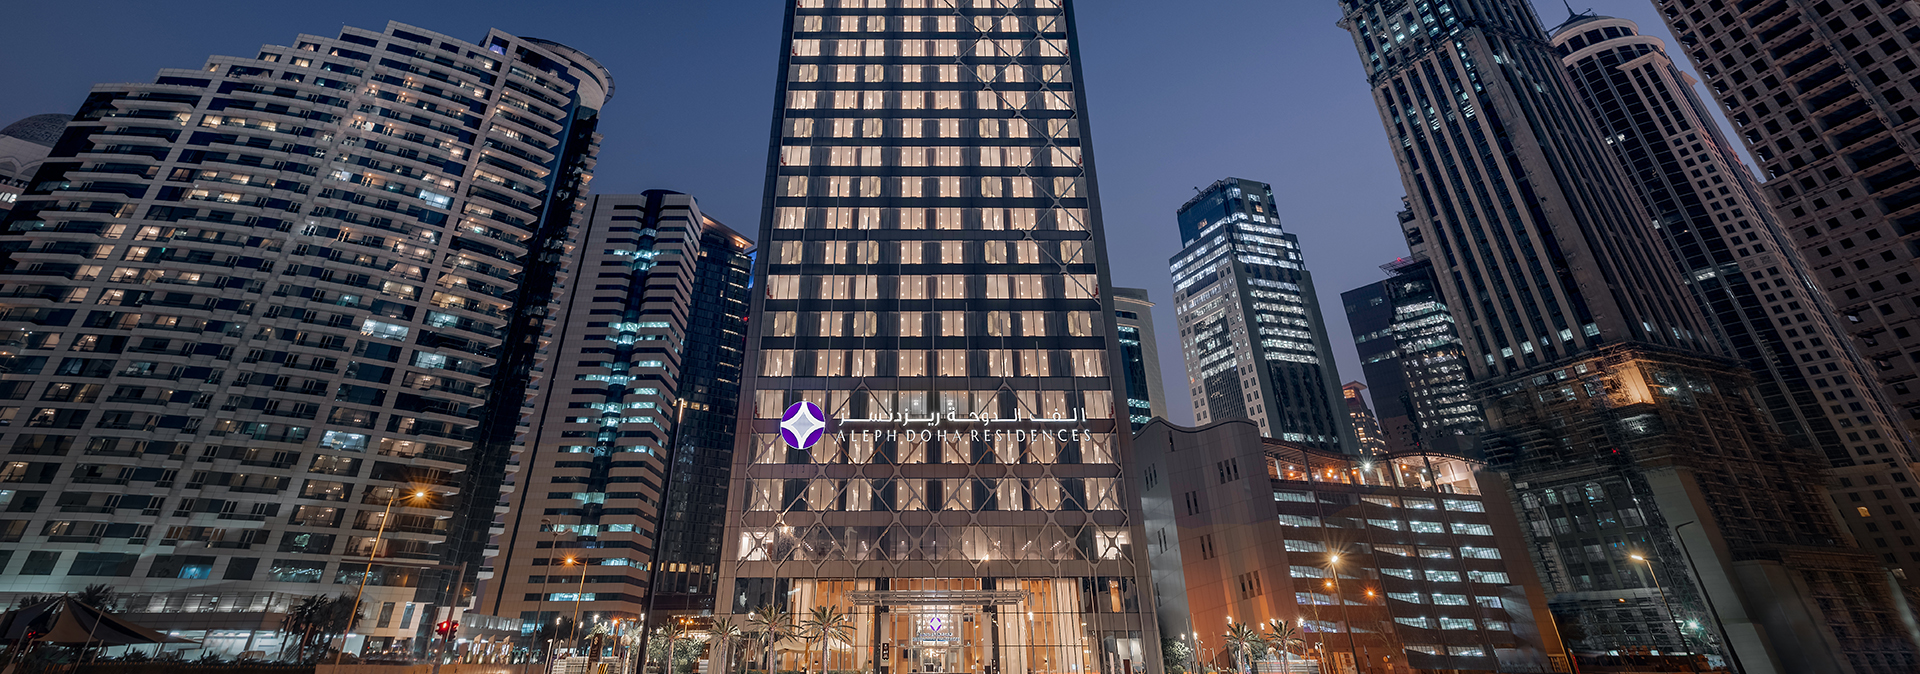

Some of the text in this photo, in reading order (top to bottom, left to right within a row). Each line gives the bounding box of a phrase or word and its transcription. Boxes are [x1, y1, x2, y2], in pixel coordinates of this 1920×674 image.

[947, 406, 1021, 426] الدوحة
[836, 429, 1091, 442] ALEPH DOHA RESIDENCES
